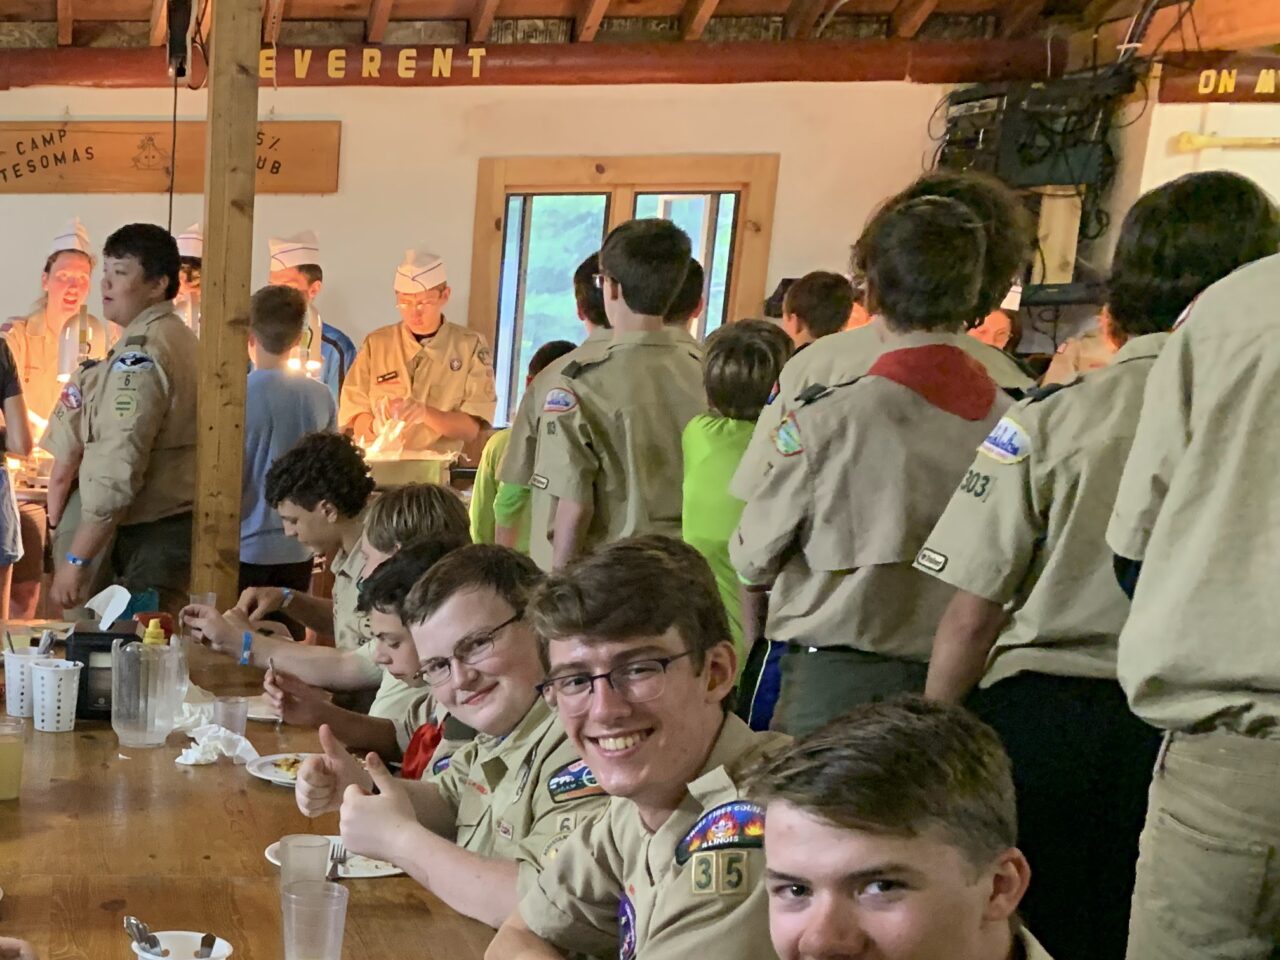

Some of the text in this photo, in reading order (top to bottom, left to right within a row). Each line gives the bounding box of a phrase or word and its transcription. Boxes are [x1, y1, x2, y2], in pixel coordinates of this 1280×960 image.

[258, 48, 487, 79] EVERENT
[1198, 69, 1280, 94] ON M
[16, 128, 68, 156] CAMP
[256, 155, 282, 175] UB
[701, 835, 740, 849] ILLINOIS
